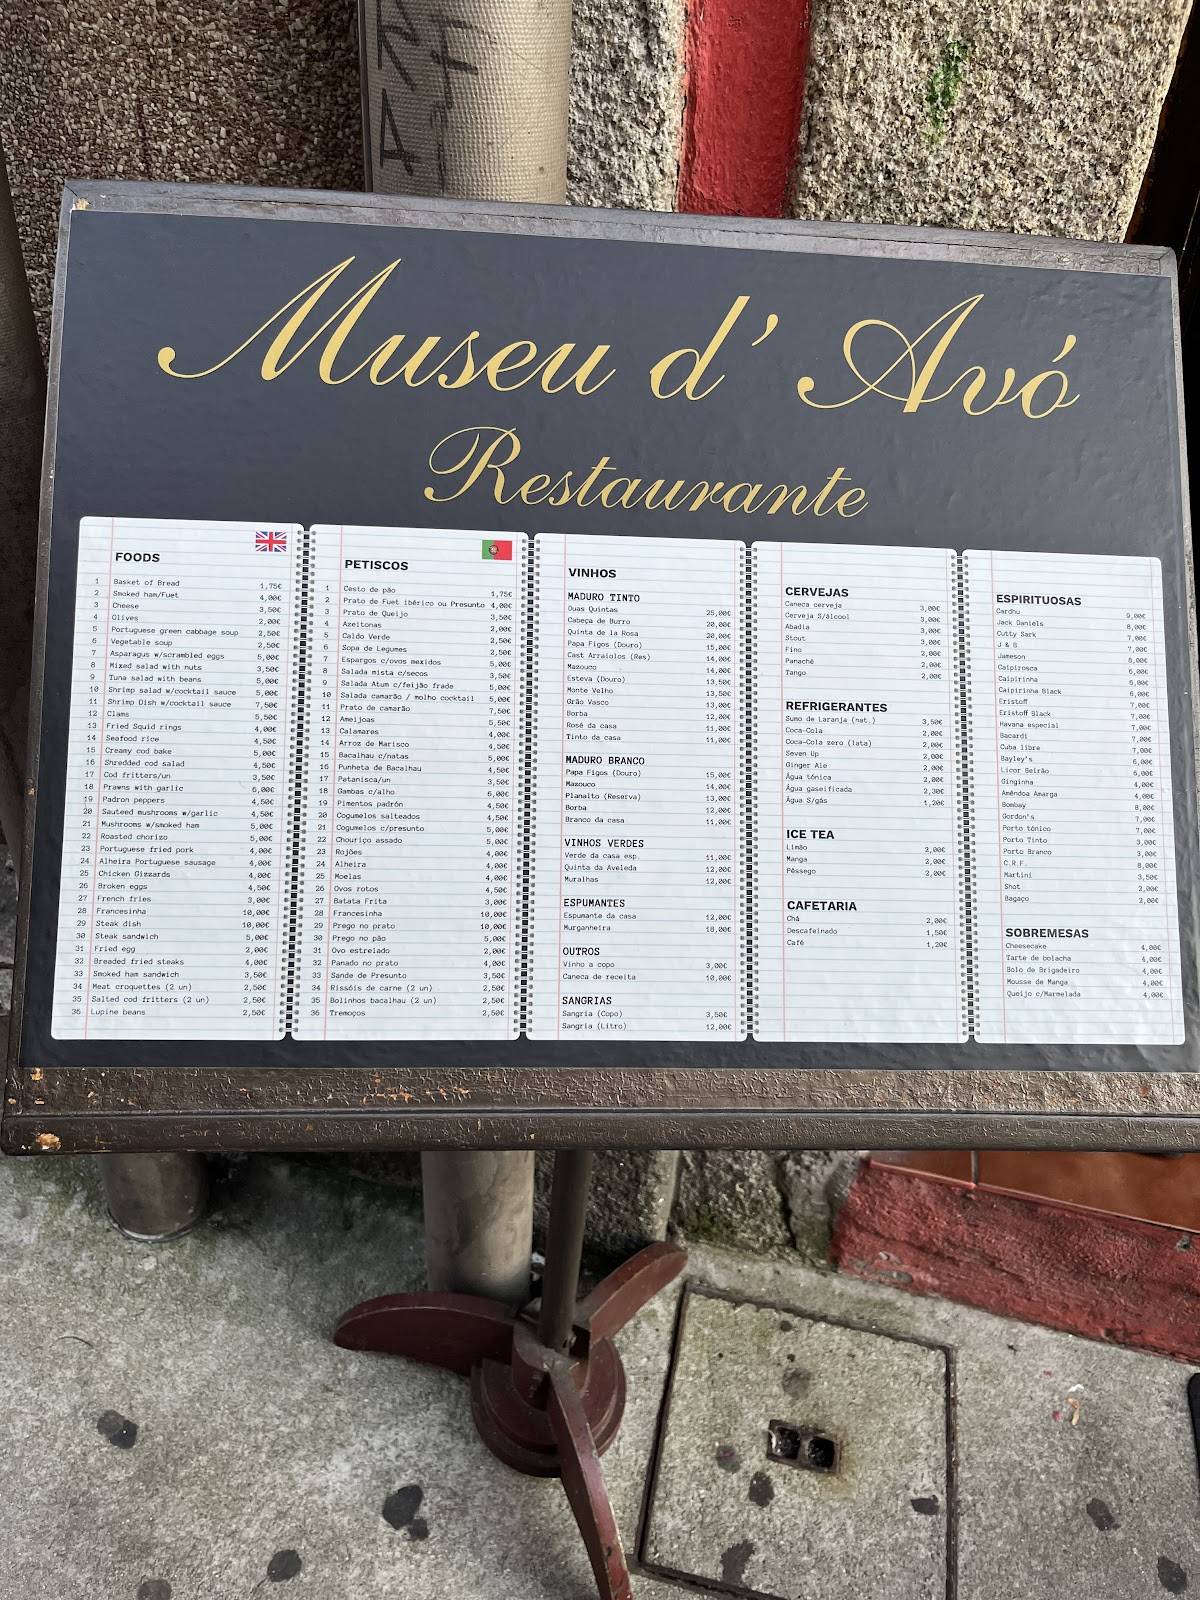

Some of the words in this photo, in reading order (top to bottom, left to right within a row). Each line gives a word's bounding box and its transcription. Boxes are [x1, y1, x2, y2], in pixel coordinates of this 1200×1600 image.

[157, 257, 613, 393] Museu
[797, 293, 1080, 419] Avó
[423, 426, 867, 518] Restaurante
[115, 552, 160, 563] FOODS
[345, 559, 408, 571] PETISCOS
[568, 568, 616, 578] VINHOS
[113, 590, 140, 598] Smoked
[259, 594, 282, 602] 4,00€
[785, 586, 849, 597] CERVEJAS
[568, 592, 604, 601] MADURO
[609, 593, 640, 603] TINTO
[996, 594, 1082, 606] ESPIRITUOSAS
[381, 610, 409, 619] Queijo
[490, 614, 512, 622] 3,50€
[588, 606, 618, 614] Quintas
[706, 609, 731, 617] 25,00€
[784, 612, 814, 620] Cerveja
[920, 616, 941, 624] 3,00€
[1016, 619, 1044, 627] Daniels
[111, 626, 156, 635] Portuguese
[185, 628, 217, 637] cabbage
[342, 632, 365, 640] Caldo
[490, 637, 512, 645] 2,50€
[785, 634, 806, 642] Stout
[567, 640, 585, 648] Papa
[588, 640, 610, 649] Figos
[613, 641, 642, 650] (Douro)
[785, 669, 807, 677] Tango
[921, 672, 942, 680] 2,00€
[89, 685, 100, 693] 10
[108, 686, 136, 694] Shrimp
[256, 689, 278, 697] 5,00€
[786, 701, 887, 712] REFRIGERANTES
[785, 726, 823, 734] Coca-Cola
[105, 734, 138, 742] Seafood
[254, 738, 277, 746] 4,50€
[378, 740, 410, 748] Marisco
[488, 743, 510, 751] 4,50€
[565, 755, 603, 765] MADURO
[608, 756, 645, 765] BRANCO
[810, 750, 819, 758] Up
[923, 753, 944, 761] 2,00€
[923, 764, 944, 772] 2,00€
[603, 792, 641, 802] (Reserva)
[706, 795, 731, 803] 13,00€
[1033, 790, 1058, 799] Amarga
[1001, 801, 1027, 810] Bombay
[336, 812, 377, 820] Cogumelos
[380, 812, 420, 820] salteados
[487, 814, 509, 822] 4,50€
[787, 829, 807, 839] ICE
[810, 830, 835, 839] TEA
[564, 838, 601, 847] VINHOS
[607, 839, 644, 848] VERDES
[81, 844, 91, 852] 23
[100, 845, 145, 854] Portuguese
[175, 846, 194, 855] pork
[249, 847, 272, 855] 4,00€
[786, 855, 808, 864] Manga
[925, 858, 946, 866] 2,00€
[486, 862, 508, 870] 4,00€
[1004, 871, 1032, 879] Martini
[1137, 873, 1159, 881] 3,50€
[706, 878, 732, 886] 12,00€
[563, 898, 625, 908] ESPUMANTES
[787, 900, 857, 911] CAFETARIA
[96, 907, 146, 915] Francesinha
[242, 909, 270, 917] 10,00€
[76, 919, 87, 927] 29
[242, 921, 270, 930] 10,00€
[787, 927, 838, 935] Descafeinado
[926, 929, 947, 937] 1,50€
[1005, 928, 1089, 938] SOBREMESAS
[926, 941, 948, 949] 1,20€
[1005, 942, 1047, 950] Cheesecake
[1141, 944, 1162, 952] 4,00€
[483, 948, 506, 956] 2,00€
[562, 947, 600, 956] OUTROS
[312, 971, 322, 979] 33
[483, 972, 506, 981] 3,50€
[562, 996, 612, 1005] SANGRIAS
[329, 1009, 366, 1018] Tremoços
[482, 1009, 505, 1018] 2,50€
[562, 1010, 593, 1018] Sangria
[597, 1009, 623, 1018] (Copo)
[705, 1011, 728, 1019] 3,50€
[561, 1022, 593, 1031] Sangria
[597, 1022, 627, 1031] (Litro)
[706, 1023, 732, 1031] 12,00€
